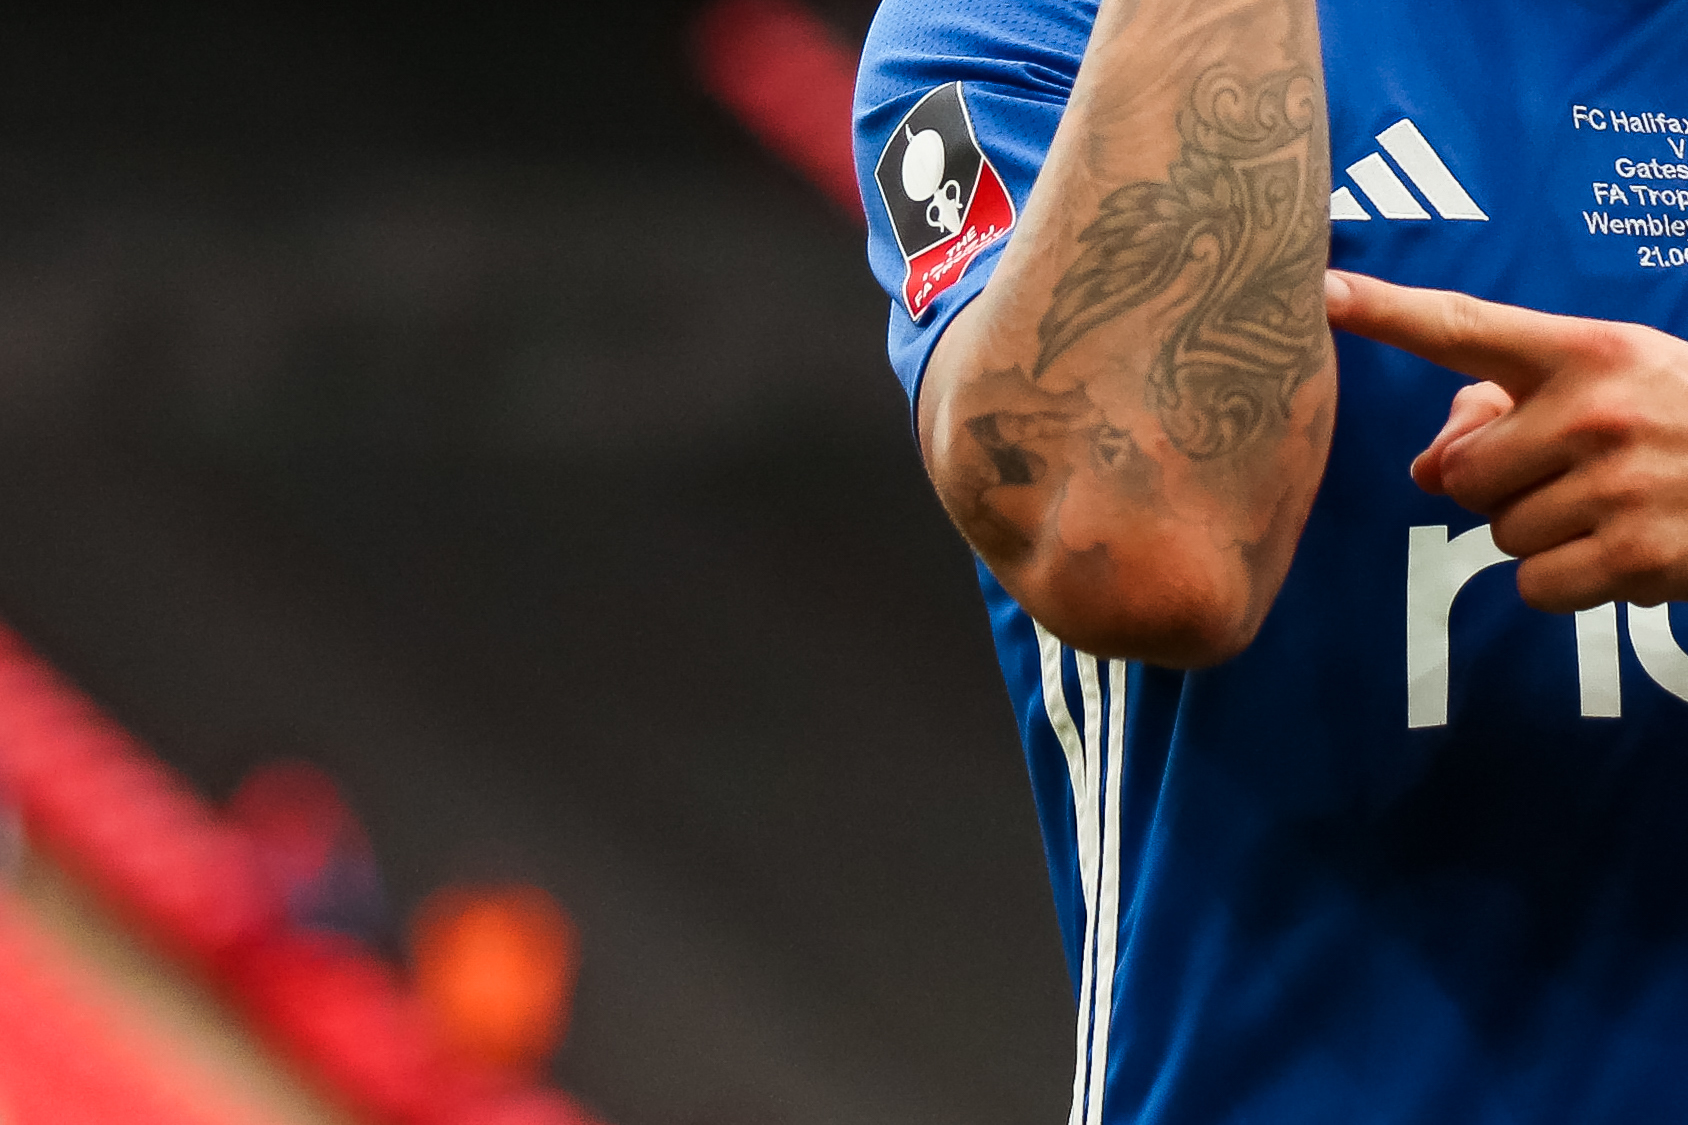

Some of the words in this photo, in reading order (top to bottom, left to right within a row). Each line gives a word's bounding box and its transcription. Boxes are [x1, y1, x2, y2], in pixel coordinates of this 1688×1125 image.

[1572, 105, 1607, 130] FC
[1592, 182, 1629, 206] FA
[946, 225, 977, 256] THE
